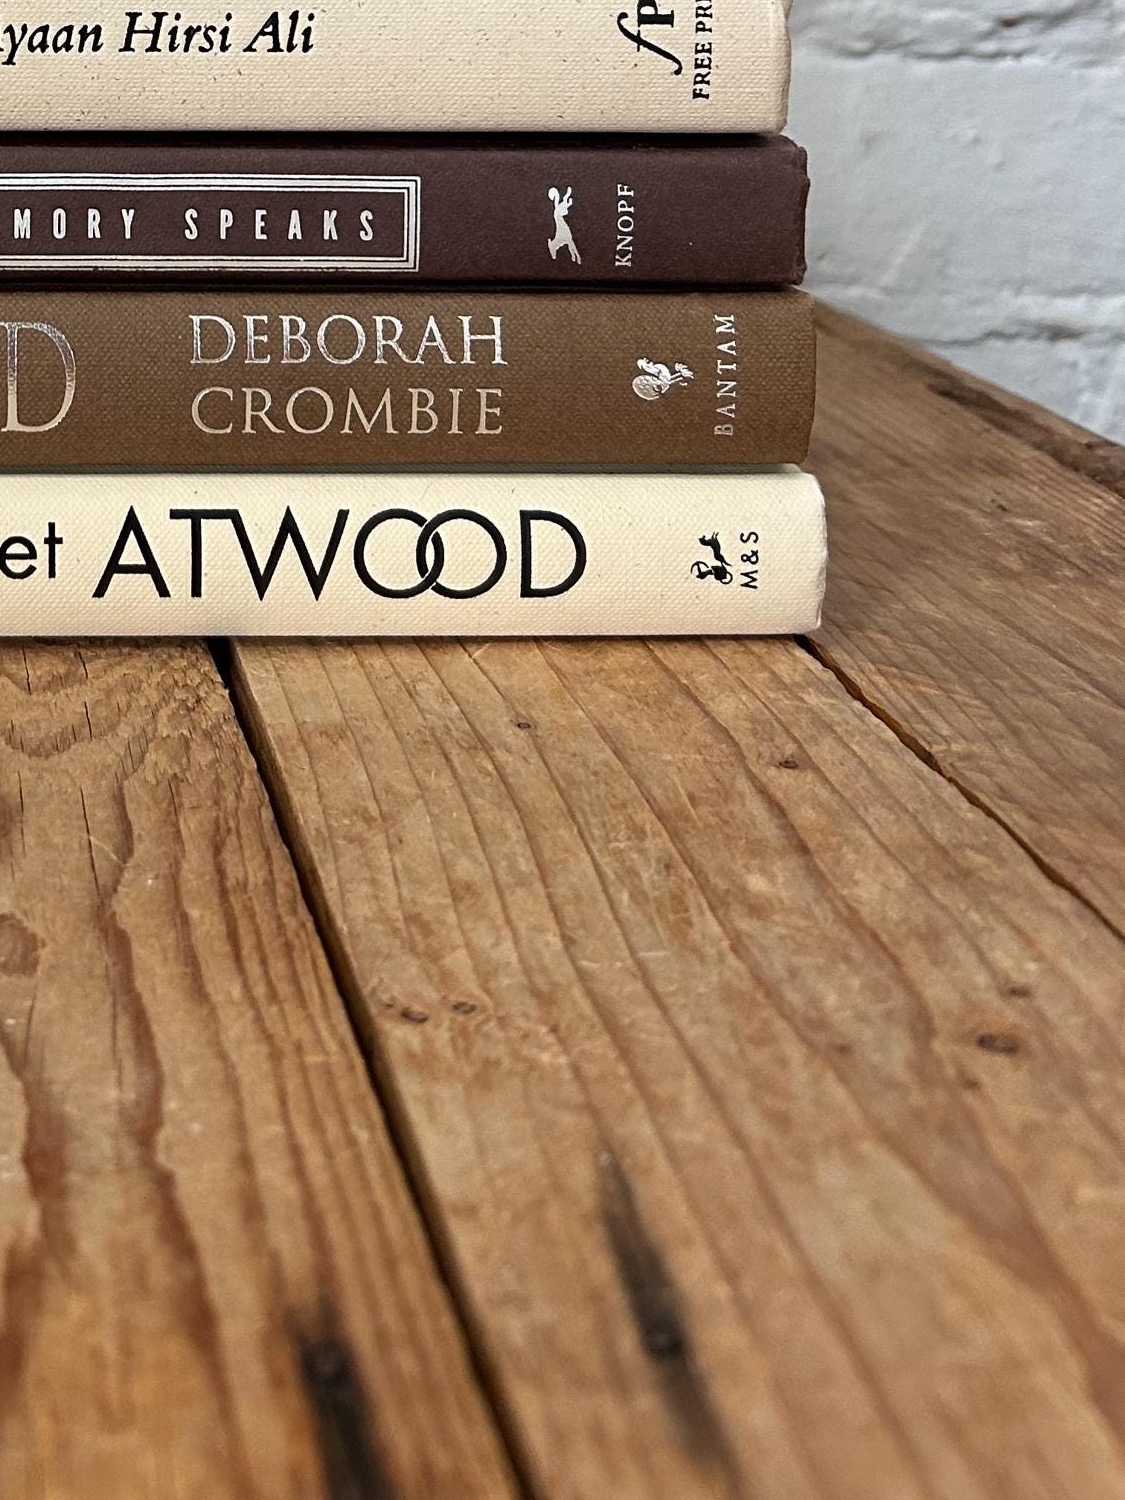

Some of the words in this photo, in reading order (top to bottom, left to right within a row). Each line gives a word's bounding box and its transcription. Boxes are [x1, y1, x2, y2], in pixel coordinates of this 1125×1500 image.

[118, 11, 233, 53] Hirsi
[242, 9, 315, 54] Ali
[692, 41, 713, 100] FREE
[184, 208, 374, 241] SPEAKS
[614, 183, 635, 267] KNOPF
[188, 314, 508, 365] DEBORAH
[714, 314, 737, 435] BANTAM
[191, 386, 503, 435] CROMBIE
[91, 505, 587, 602] ATWOOD
